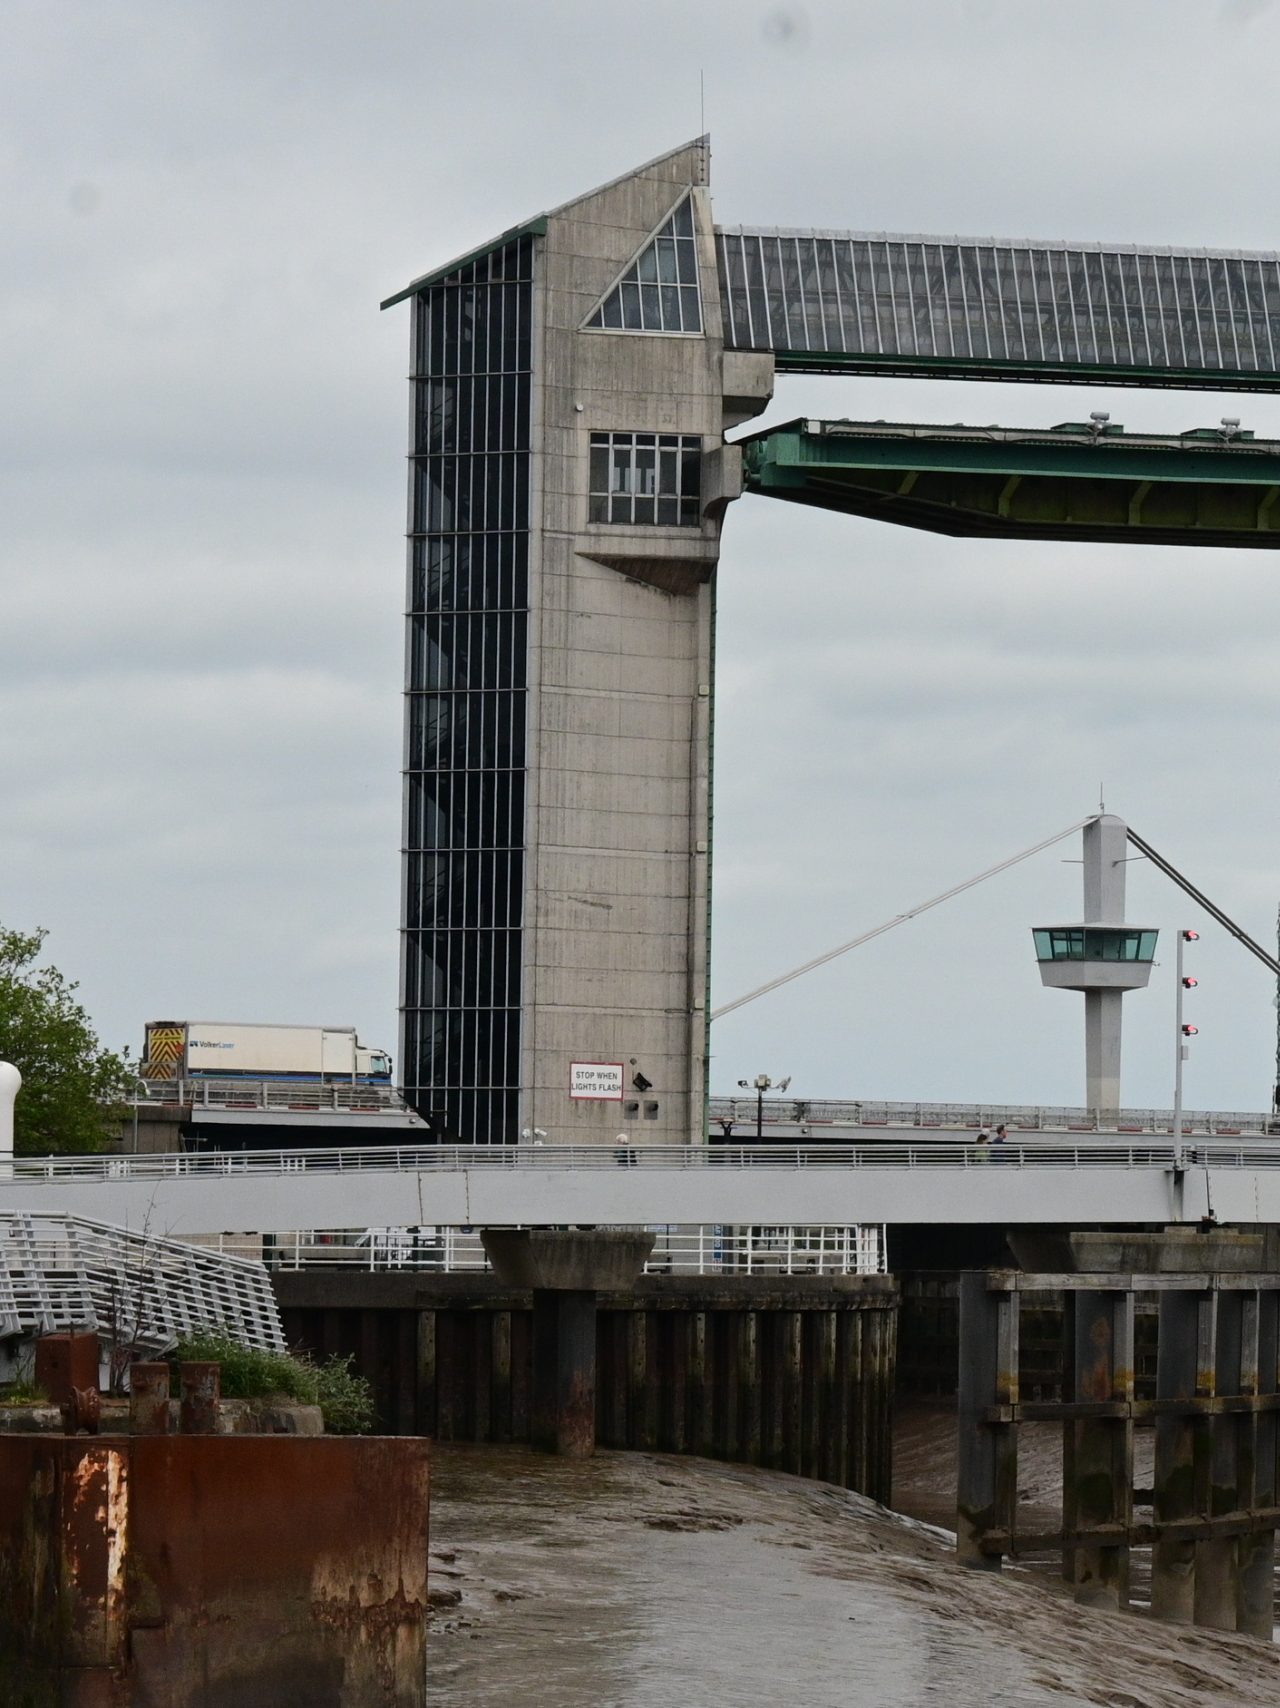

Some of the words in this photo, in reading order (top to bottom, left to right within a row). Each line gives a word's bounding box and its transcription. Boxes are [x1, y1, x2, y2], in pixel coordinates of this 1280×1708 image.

[576, 1071, 595, 1079] STOP
[597, 1072, 618, 1080] WHEN
[571, 1083, 597, 1091] LIGHTS
[598, 1083, 621, 1091] FLASH
